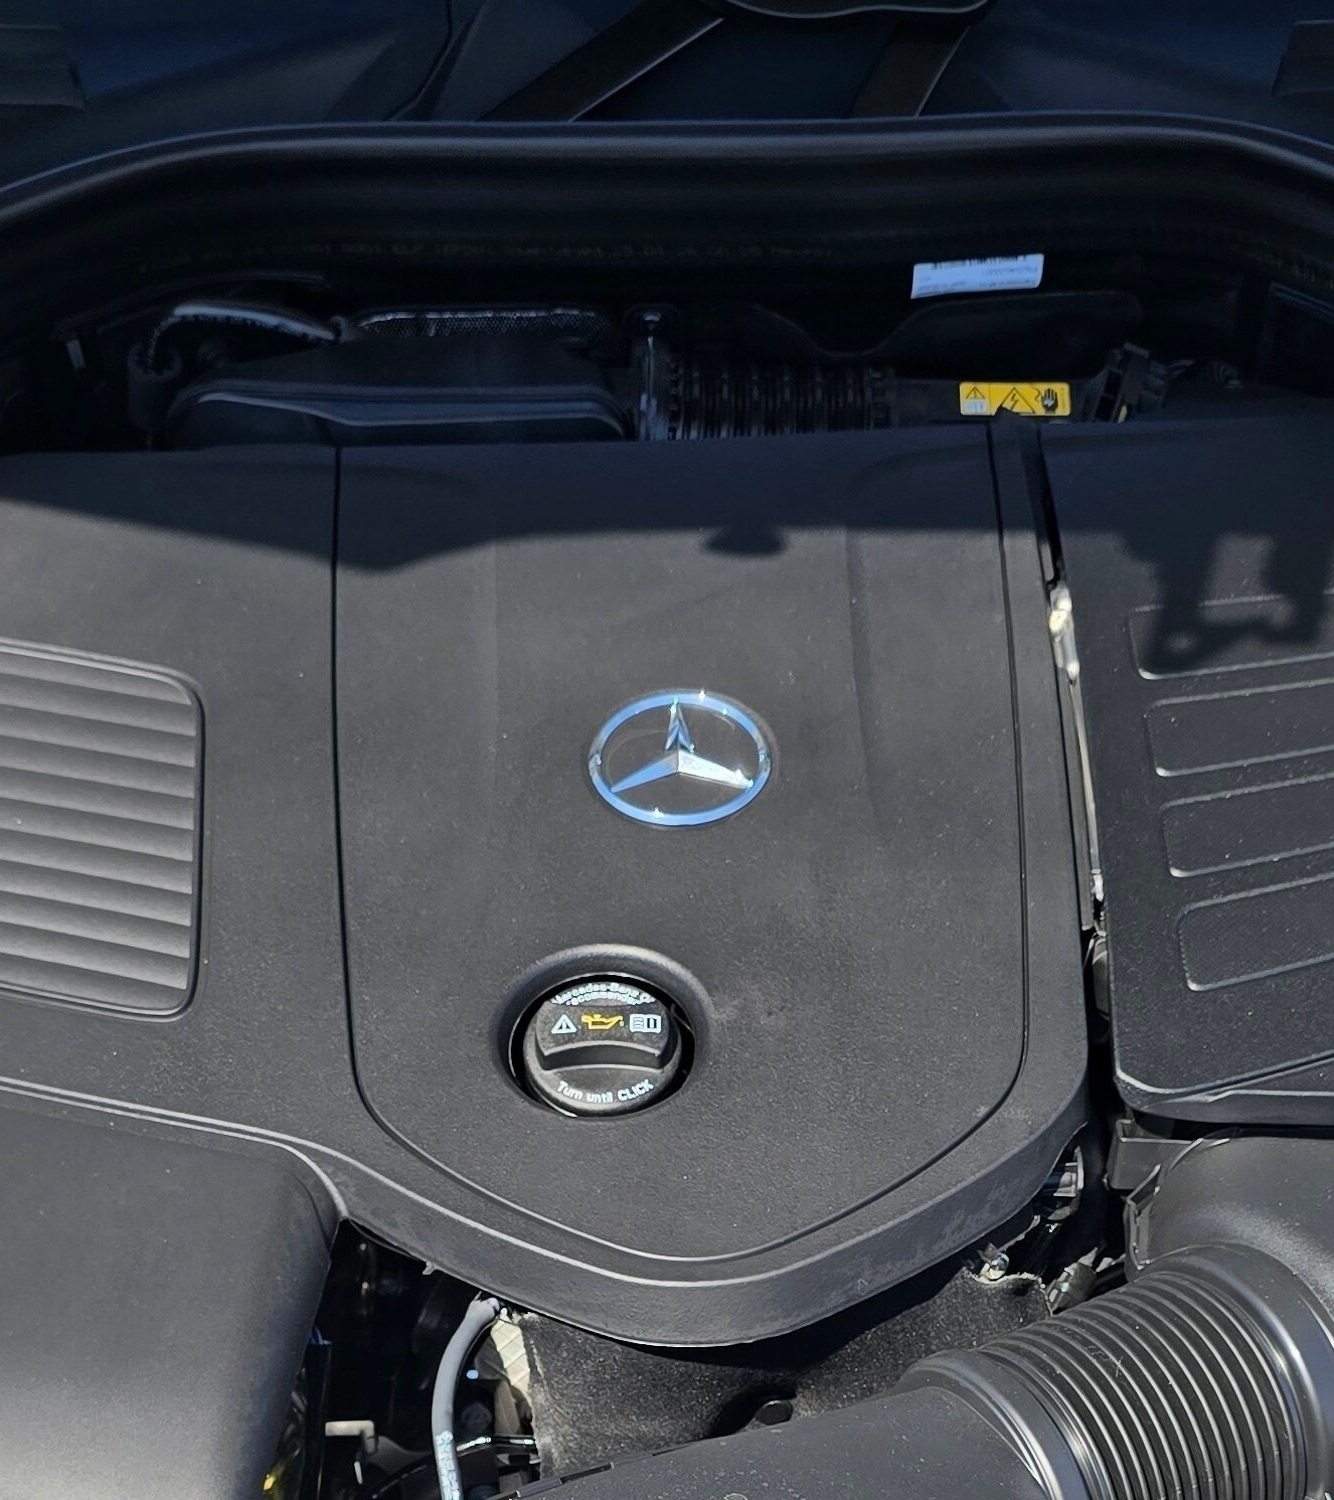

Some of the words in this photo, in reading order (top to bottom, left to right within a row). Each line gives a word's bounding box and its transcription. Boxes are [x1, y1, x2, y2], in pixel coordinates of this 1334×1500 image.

[557, 1080, 584, 1101] Turn
[585, 1091, 614, 1104] until
[617, 1078, 654, 1102] CLICK
